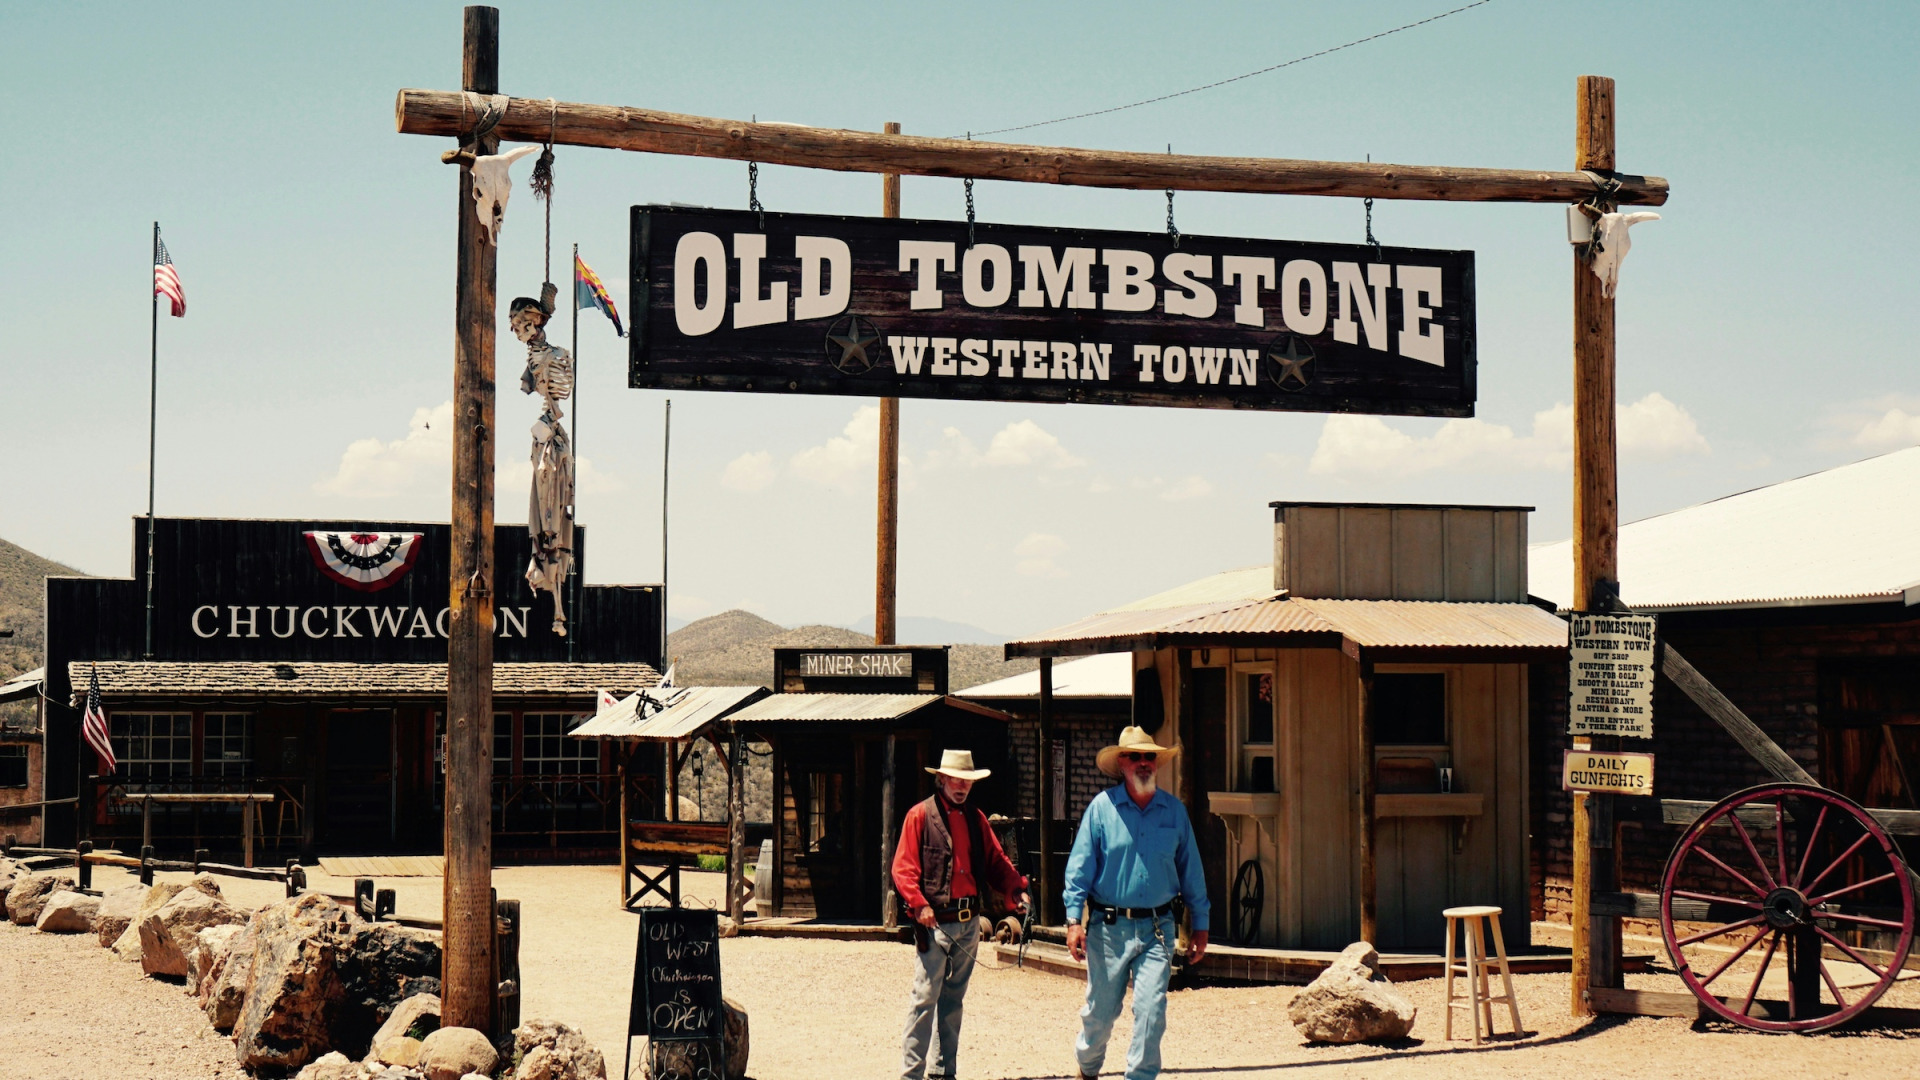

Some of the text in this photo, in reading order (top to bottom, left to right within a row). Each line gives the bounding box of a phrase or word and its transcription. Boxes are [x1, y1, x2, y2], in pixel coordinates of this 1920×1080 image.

[674, 231, 1446, 368] OLD TOMBSTONE
[887, 336, 1260, 387] WESTERN TOWN
[191, 605, 532, 639] CHUCKWAN
[1573, 619, 1652, 641] OLD TOMBSTONE
[1574, 638, 1651, 651] WESTERN TOWN
[1593, 652, 1630, 661] GIFT SHOP
[807, 655, 903, 675] MINER SHAK
[1578, 662, 1644, 672] GUNFIGHT SHOWS
[1619, 672, 1637, 680] GOLD
[1610, 680, 1645, 689] GALLERY
[1591, 688, 1630, 697] MINI GOLF
[1585, 696, 1635, 706] RESTAURANT
[1577, 704, 1644, 714] CANTINA & MORE
[1584, 716, 1635, 725] FREE ENTRY
[1619, 725, 1645, 733] PARK!
[1587, 757, 1629, 771] DAILY
[1570, 771, 1645, 788] GUNFIGHTS
[650, 922, 684, 941] OLD
[667, 941, 712, 960] WEST
[654, 1001, 714, 1034] OPEN
